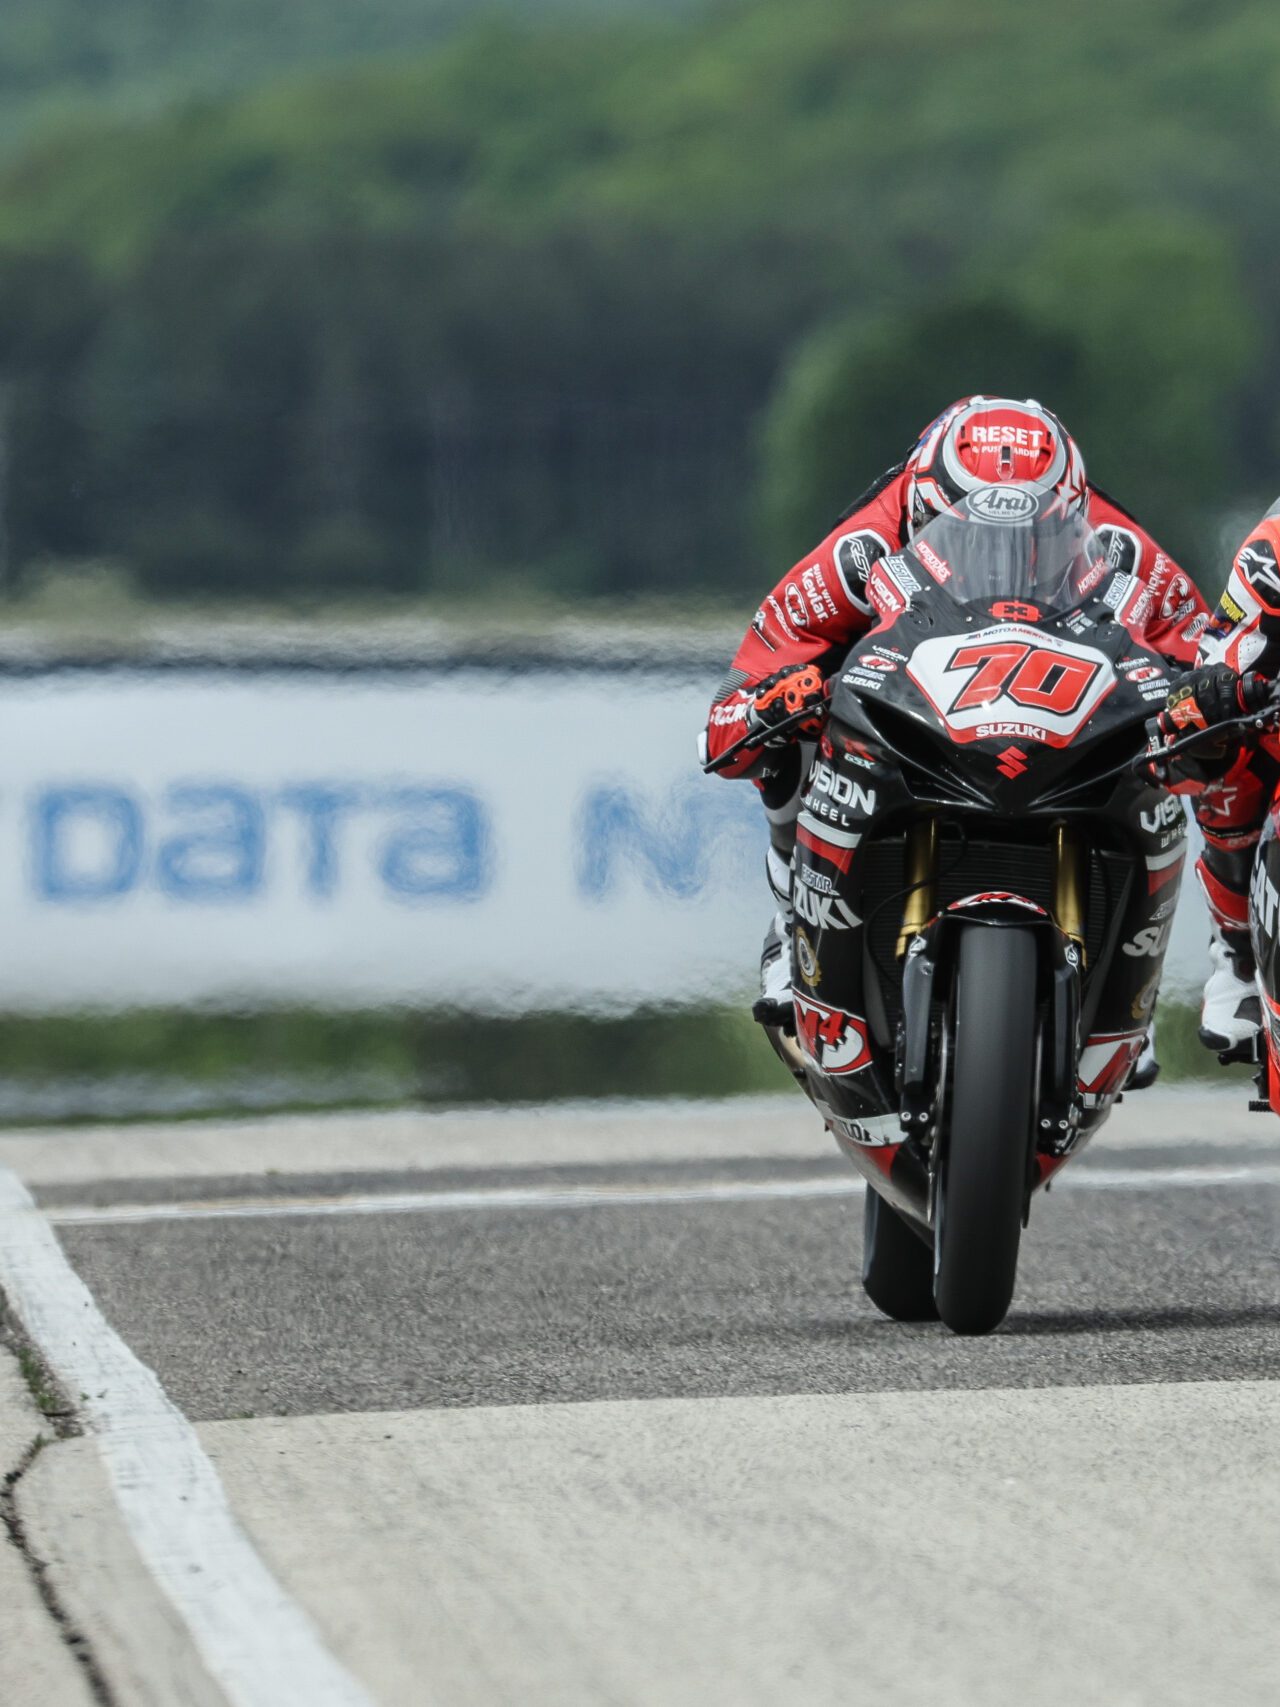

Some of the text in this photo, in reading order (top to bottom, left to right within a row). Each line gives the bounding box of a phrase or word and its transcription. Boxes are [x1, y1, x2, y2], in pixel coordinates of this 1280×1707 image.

[972, 426, 1043, 447] RESET
[974, 489, 1030, 511] Arai
[812, 563, 838, 616] BUILT WITH
[870, 573, 901, 612] VISION
[841, 674, 881, 691] SUZUKI
[943, 641, 1104, 718] 70
[976, 723, 1046, 740] SUZUKI
[808, 760, 876, 816] VISION
[805, 794, 850, 827] WHEEL
[794, 874, 864, 930] ZUKI
